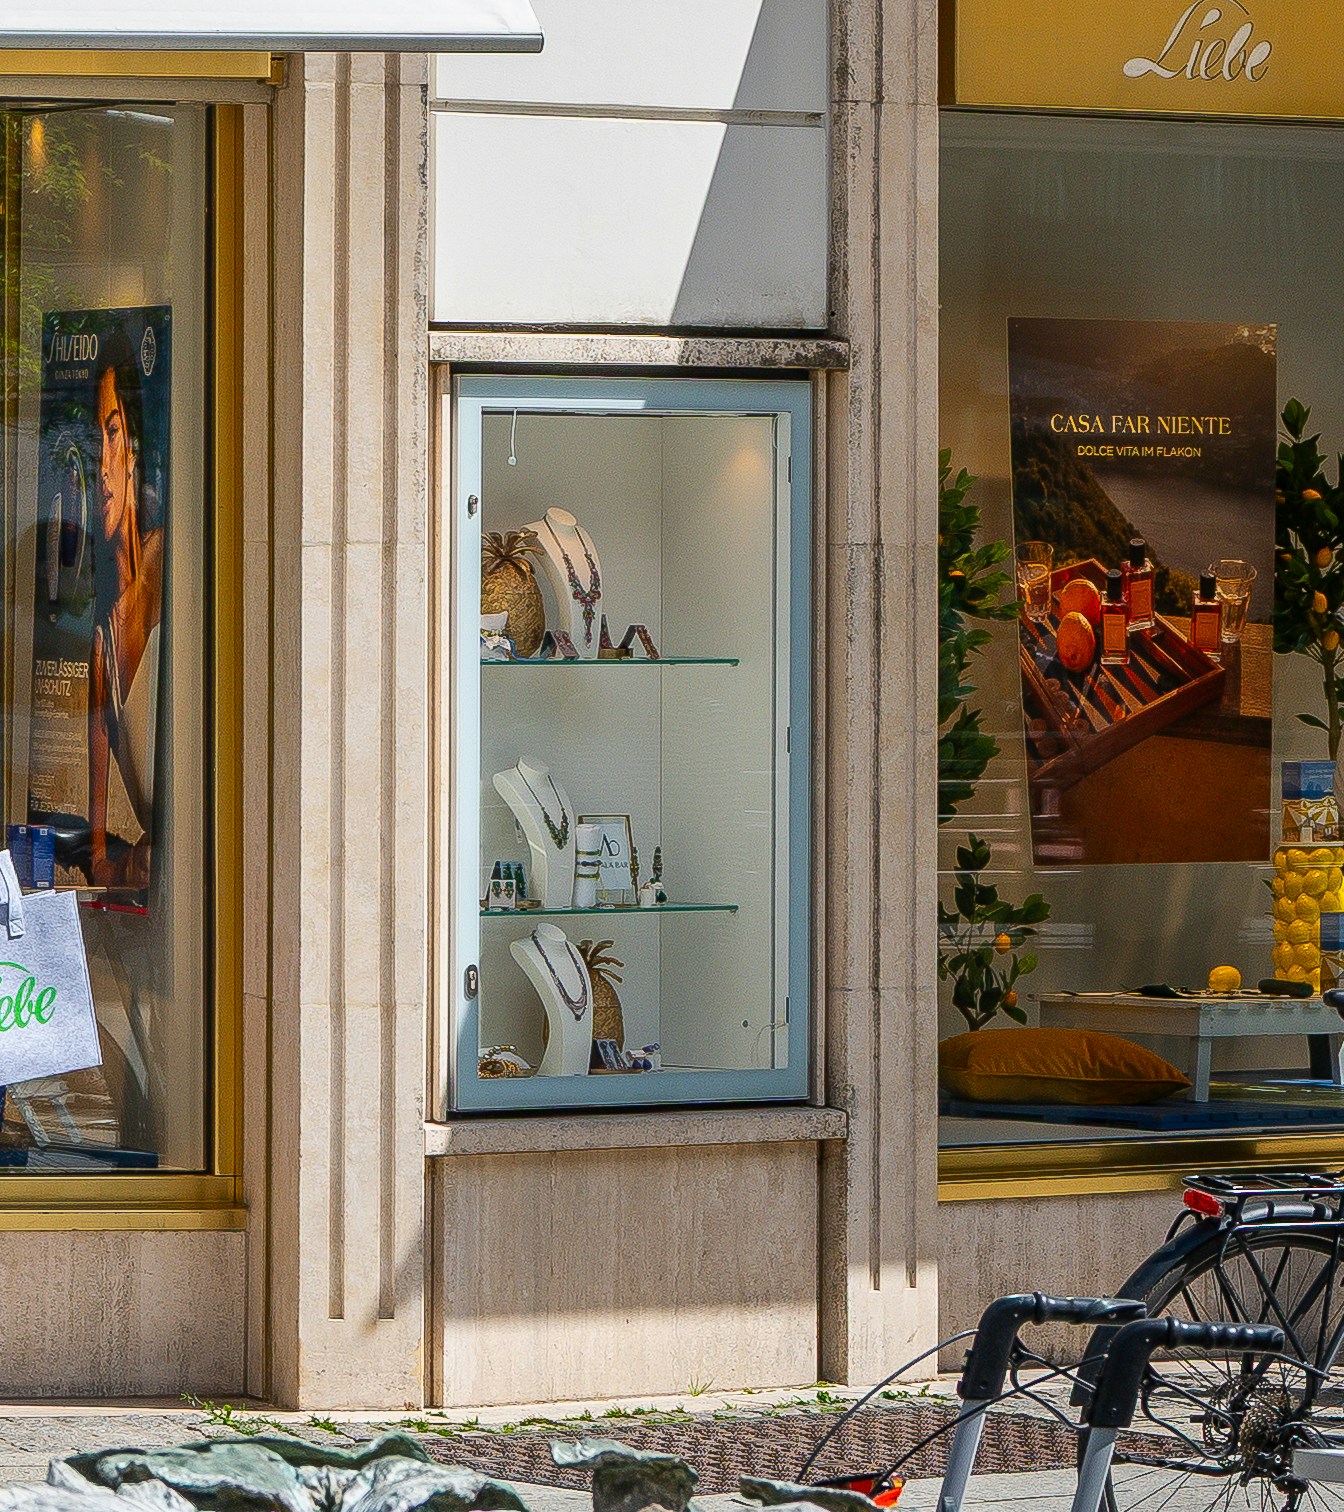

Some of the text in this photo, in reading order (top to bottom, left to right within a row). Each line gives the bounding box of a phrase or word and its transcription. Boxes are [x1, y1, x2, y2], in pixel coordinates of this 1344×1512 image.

[45, 332, 99, 363] SHISEIDO
[1050, 413, 1232, 435] CASA FAR NIENTE
[1077, 446, 1202, 458] DOLCE VITA IM FLAKON
